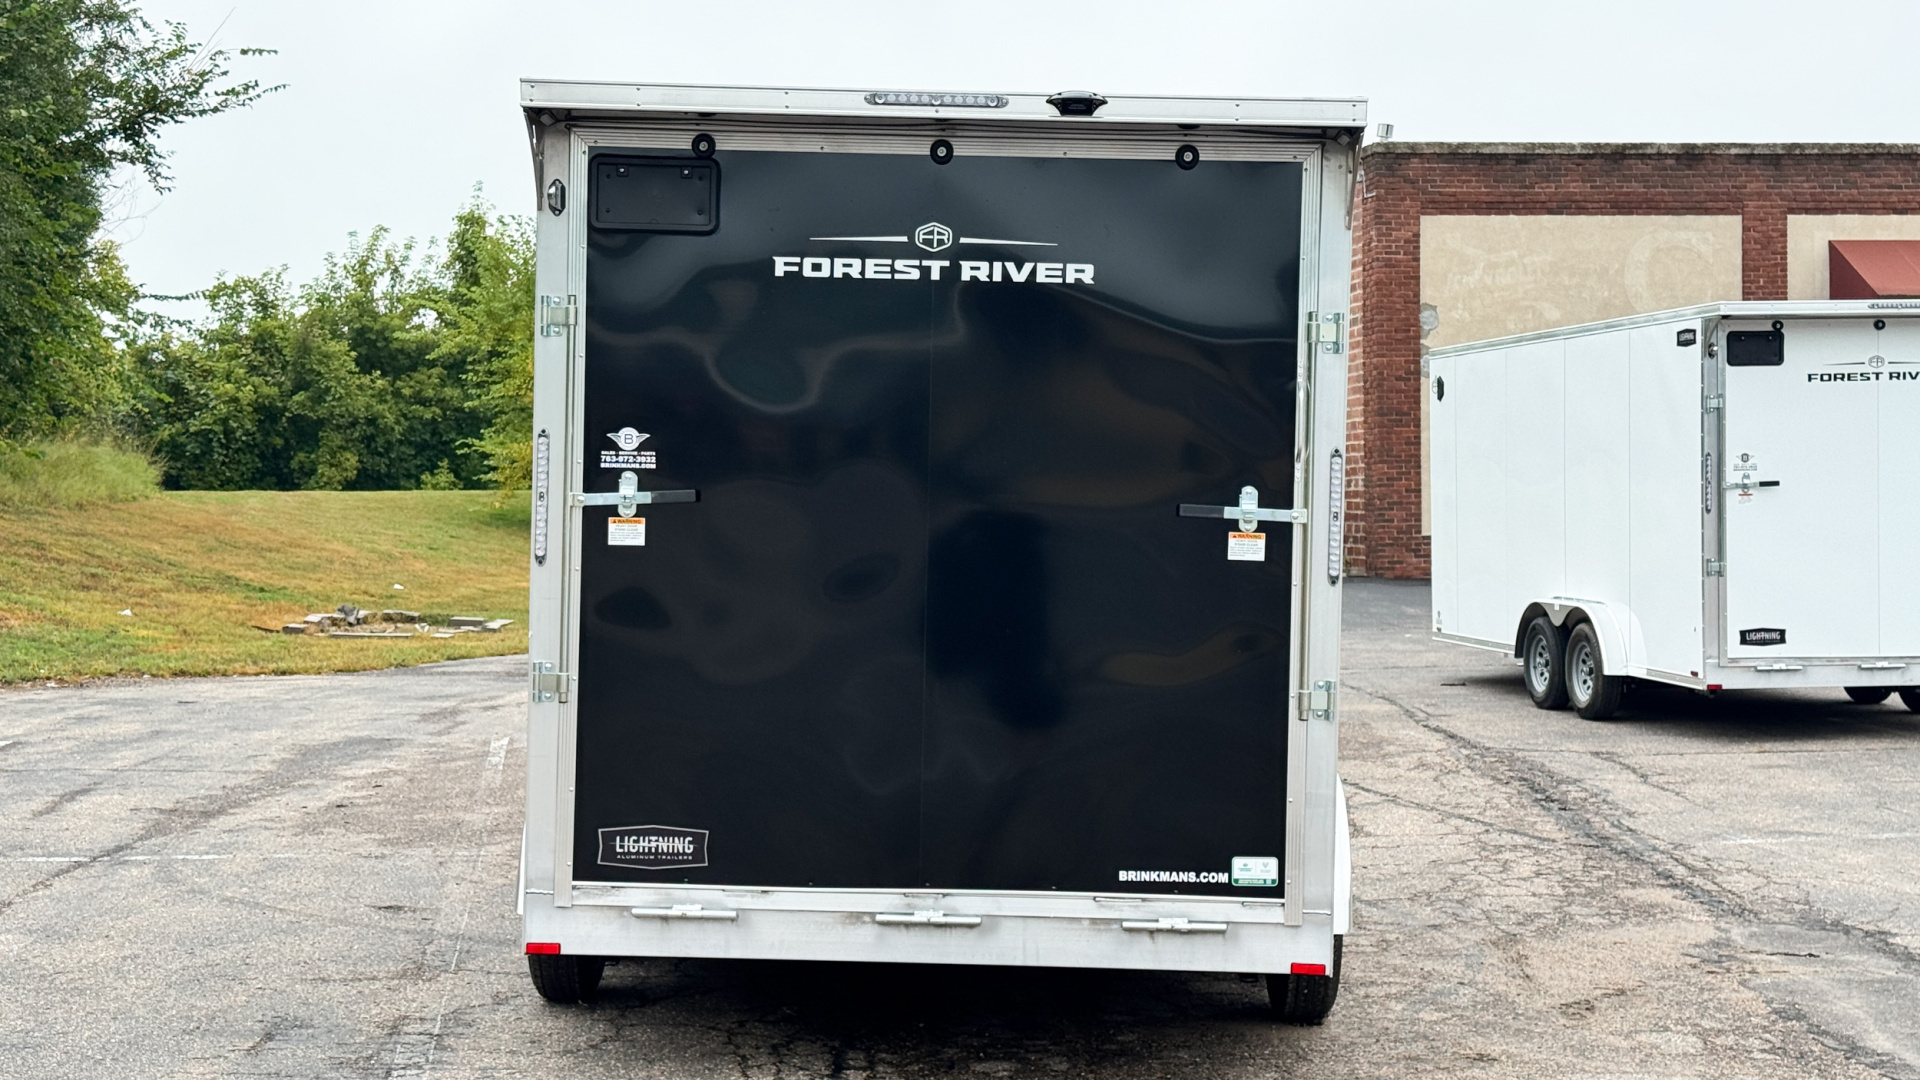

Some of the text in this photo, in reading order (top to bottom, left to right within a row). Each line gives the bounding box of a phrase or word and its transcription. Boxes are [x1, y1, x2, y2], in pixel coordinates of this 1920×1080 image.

[772, 256, 1095, 285] FOREST RIVER
[1807, 372, 1884, 383] FOREST
[600, 455, 656, 463] 763-972-3932
[1746, 631, 1781, 640] LIGHTNING
[615, 835, 694, 854] LIGHTNING
[1118, 870, 1229, 884] BRINKMANS.COM
